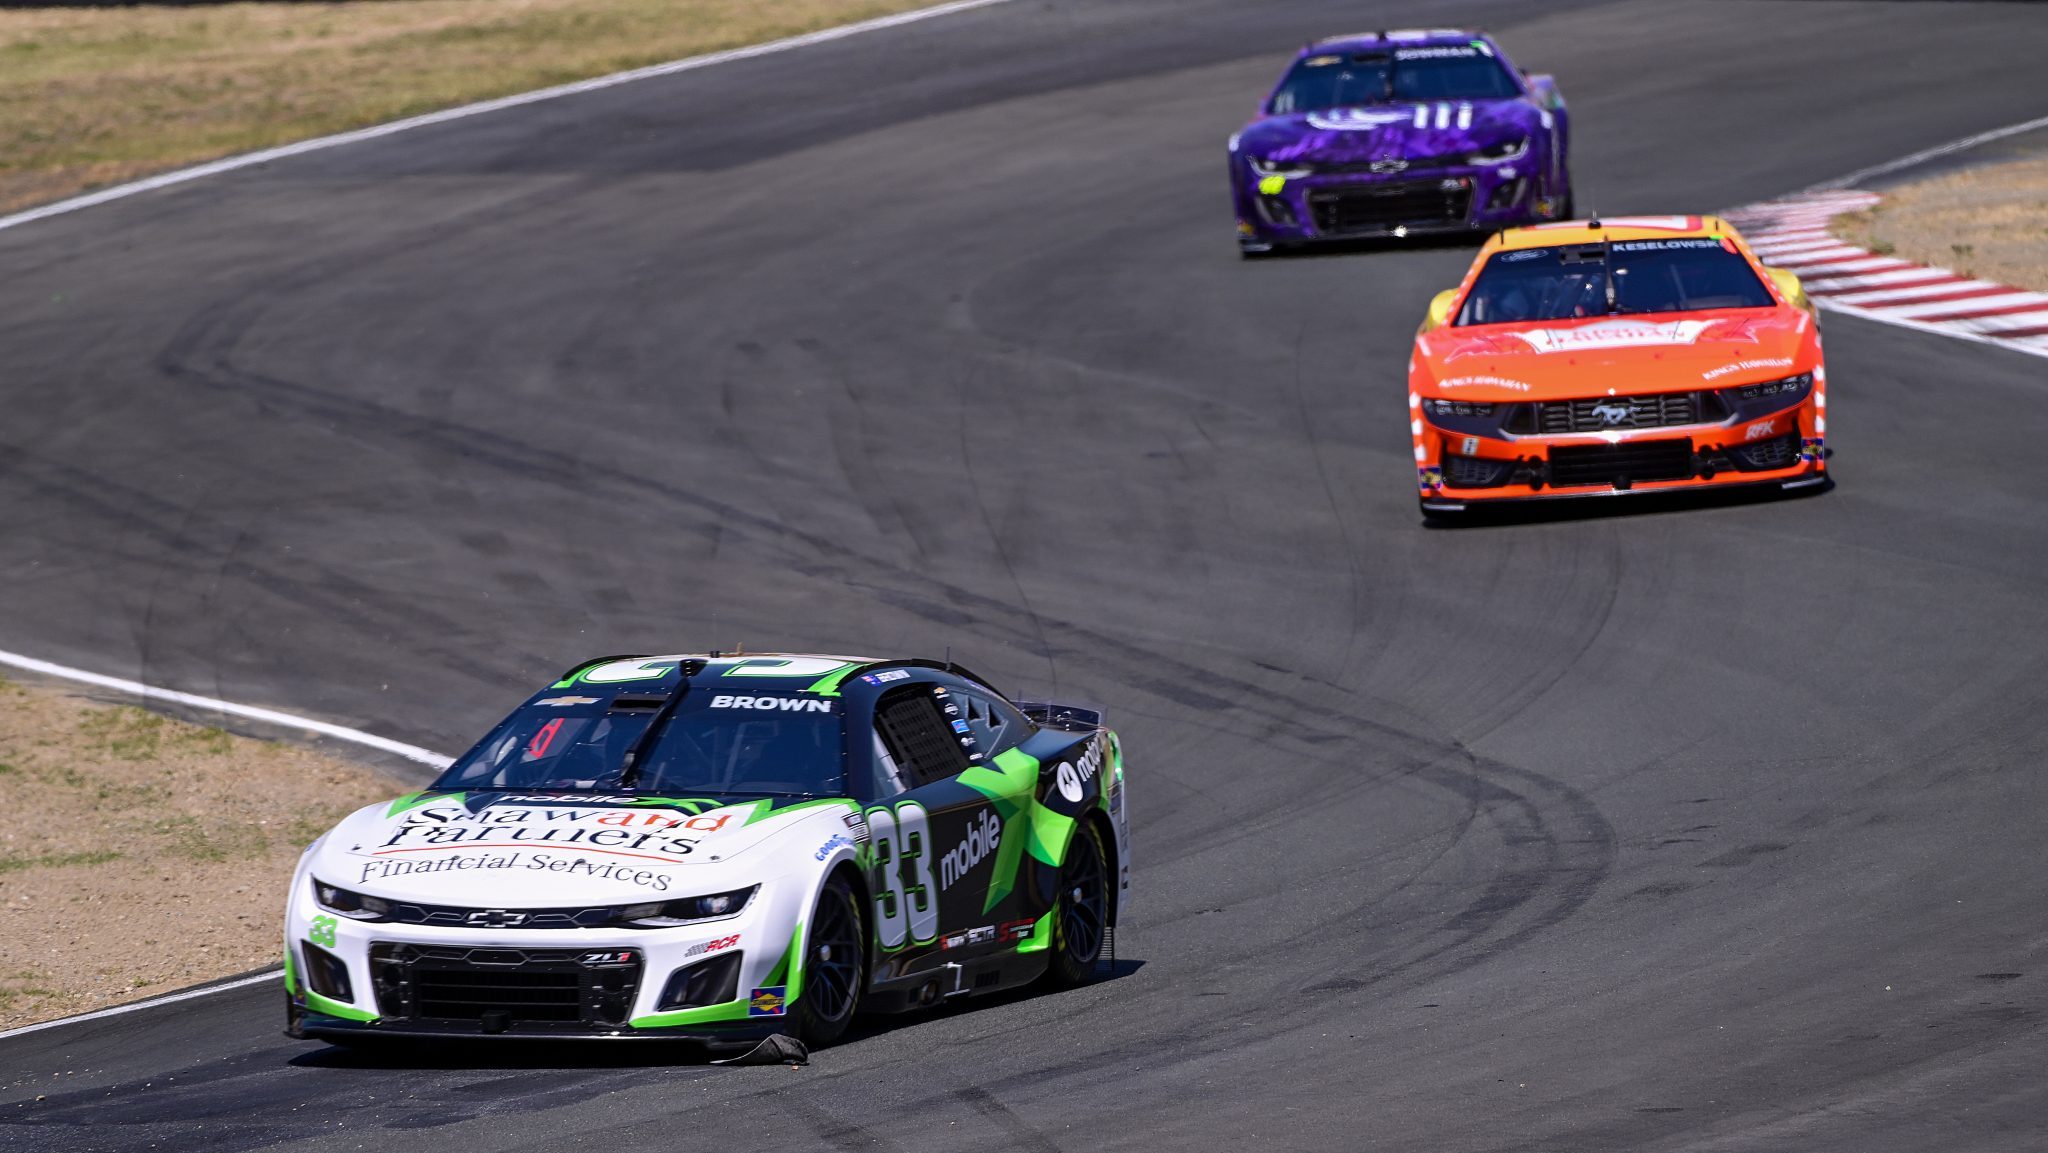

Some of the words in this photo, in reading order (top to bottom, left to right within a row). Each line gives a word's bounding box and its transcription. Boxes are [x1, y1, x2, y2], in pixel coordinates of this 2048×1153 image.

[1745, 421, 1774, 440] RFK
[710, 695, 832, 713] BROWN
[941, 808, 1000, 891] mobile
[359, 853, 520, 884] Financial
[527, 854, 671, 891] Services
[866, 801, 938, 951] 33
[309, 915, 337, 948] 33
[704, 934, 740, 953] RCR
[582, 952, 632, 964] ZL1
